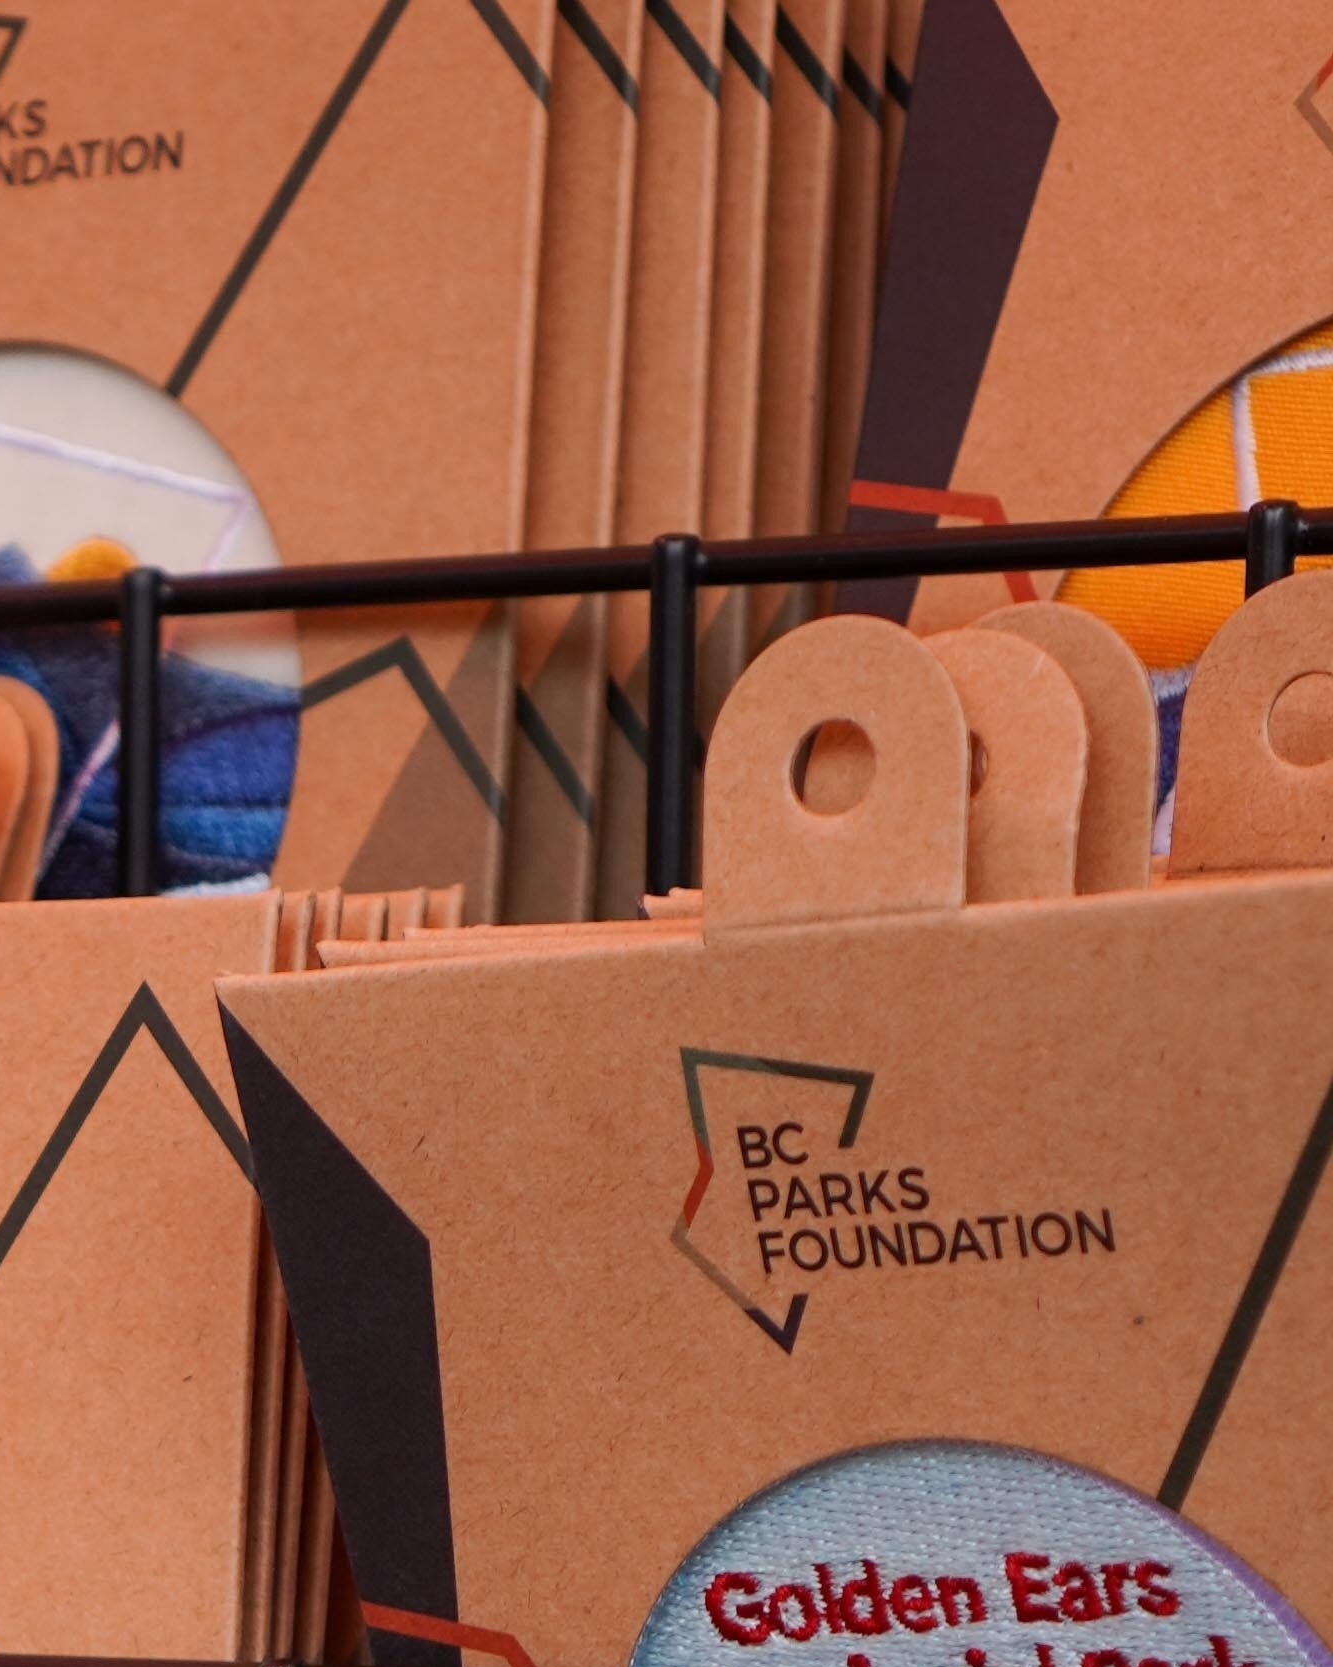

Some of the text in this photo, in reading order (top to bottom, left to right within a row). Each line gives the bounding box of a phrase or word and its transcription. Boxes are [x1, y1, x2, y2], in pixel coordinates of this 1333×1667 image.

[737, 1122, 809, 1169] BC
[747, 1167, 931, 1222] PARKS
[758, 1207, 1116, 1274] FOUNDATION
[704, 1551, 1183, 1646] Golden Ears
